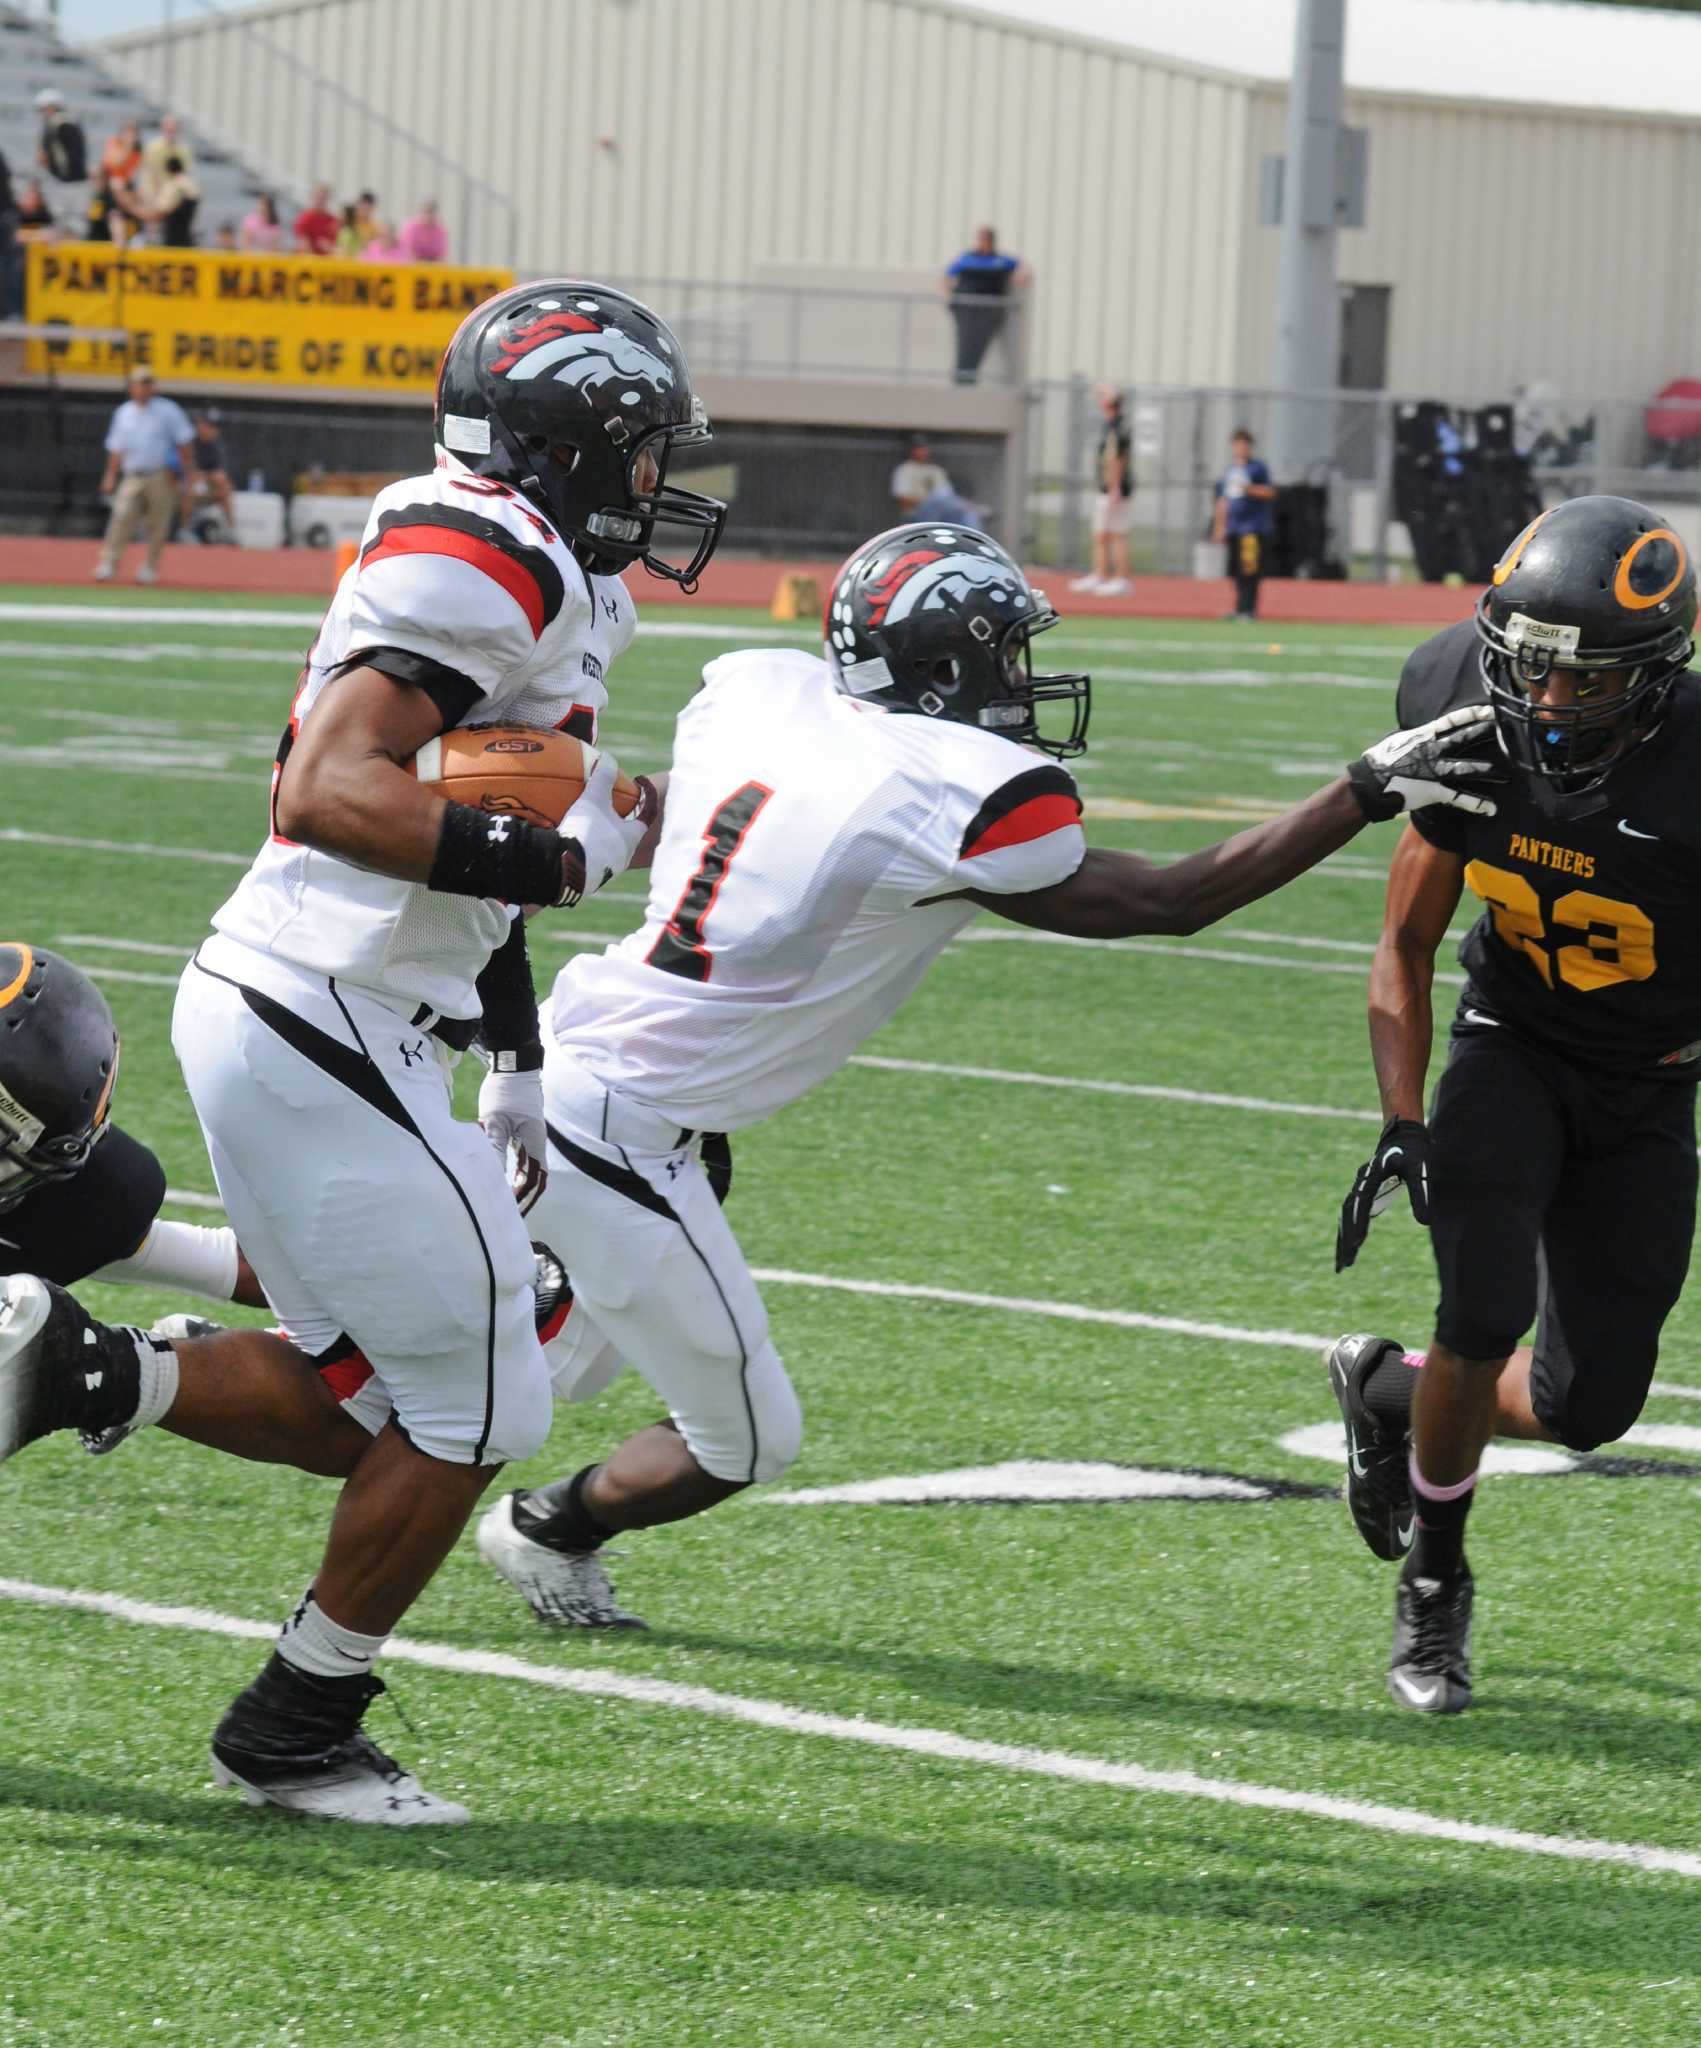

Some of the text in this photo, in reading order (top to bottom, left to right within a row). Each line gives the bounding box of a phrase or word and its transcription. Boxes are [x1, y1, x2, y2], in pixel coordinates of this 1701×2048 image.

[42, 256, 198, 298] PANTHER
[217, 266, 395, 309] MARCHING
[172, 333, 280, 372] PRIDE
[302, 340, 343, 374] OF
[362, 344, 447, 378] KOH
[495, 741, 536, 752] GST
[1508, 834, 1596, 879] PANTHERS
[643, 779, 776, 983] 1
[1463, 858, 1657, 992] 23
[0, 1091, 30, 1123] chutt
